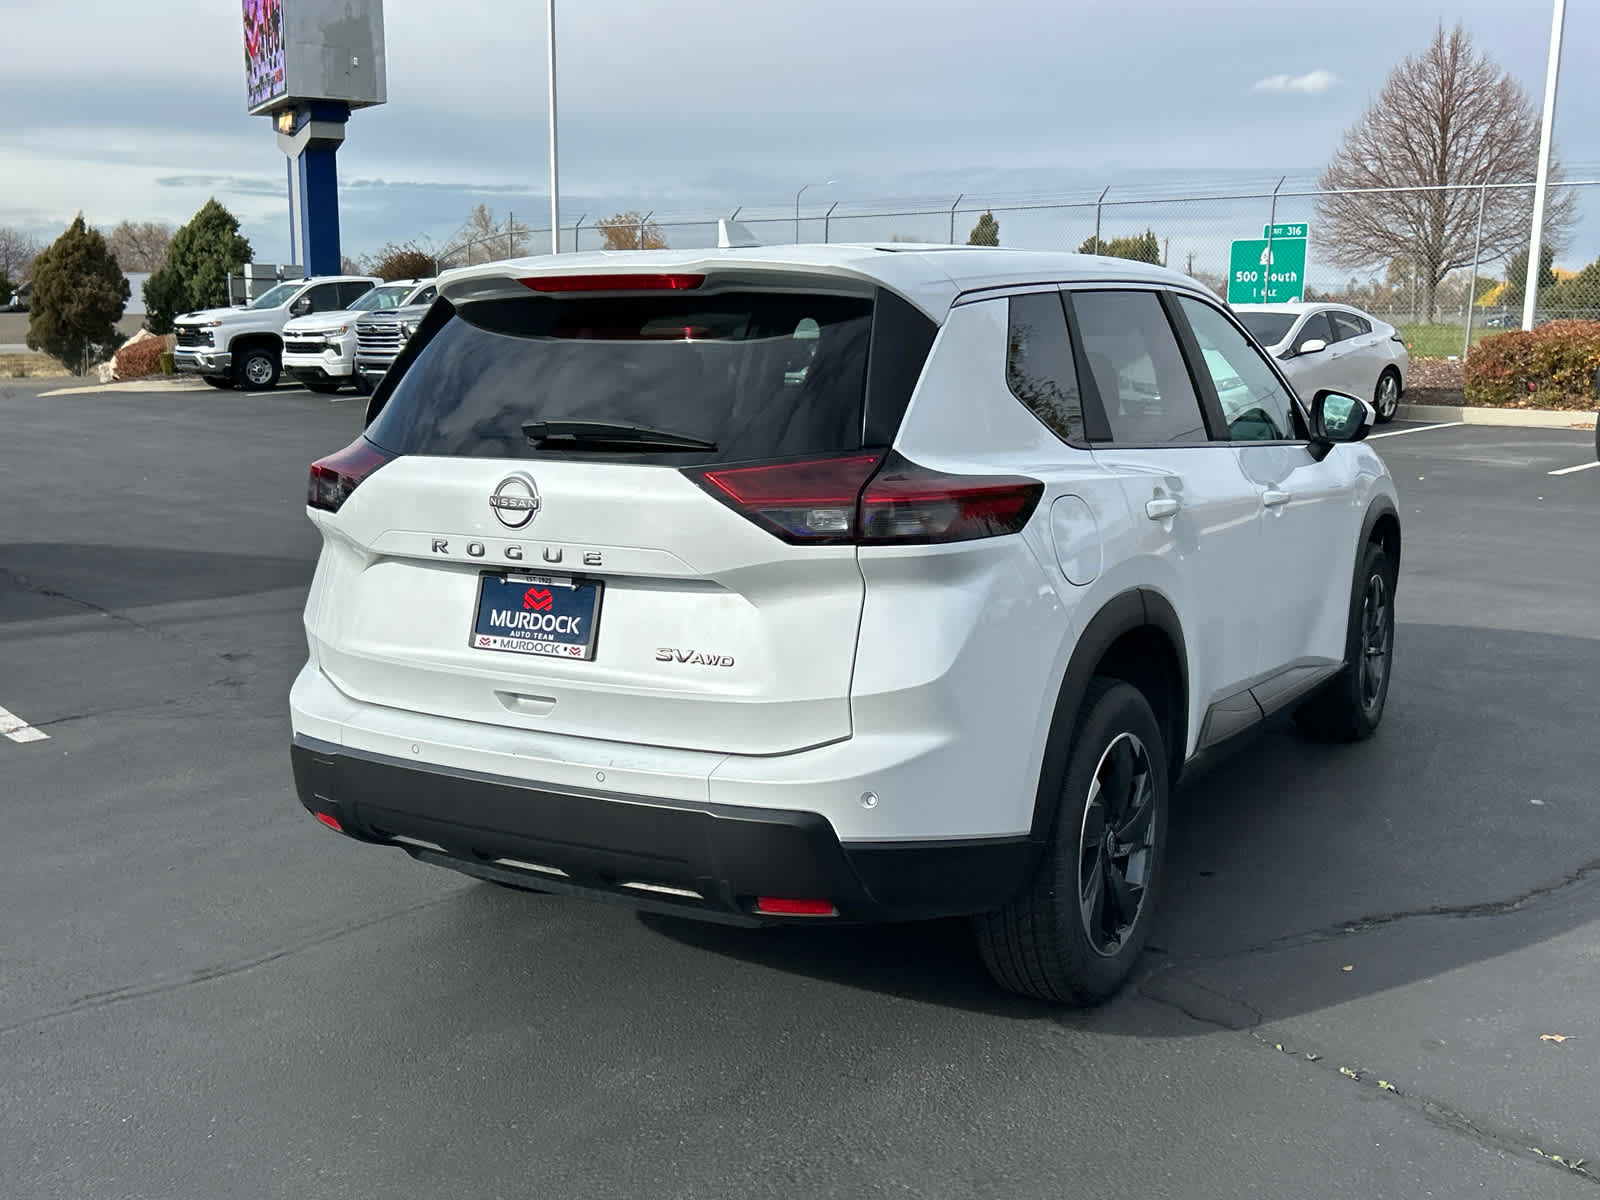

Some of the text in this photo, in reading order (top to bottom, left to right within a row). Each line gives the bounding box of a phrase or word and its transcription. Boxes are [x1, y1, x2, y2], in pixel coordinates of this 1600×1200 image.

[1286, 226, 1302, 235] 316
[1235, 271, 1258, 282] 500
[1252, 287, 1257, 297] 1
[490, 496, 537, 508] NISSAN
[432, 537, 602, 566] ROGUE
[490, 609, 581, 635] MURDOCK
[510, 630, 554, 641] AUTO TEAM
[500, 639, 560, 655] MURDOCK
